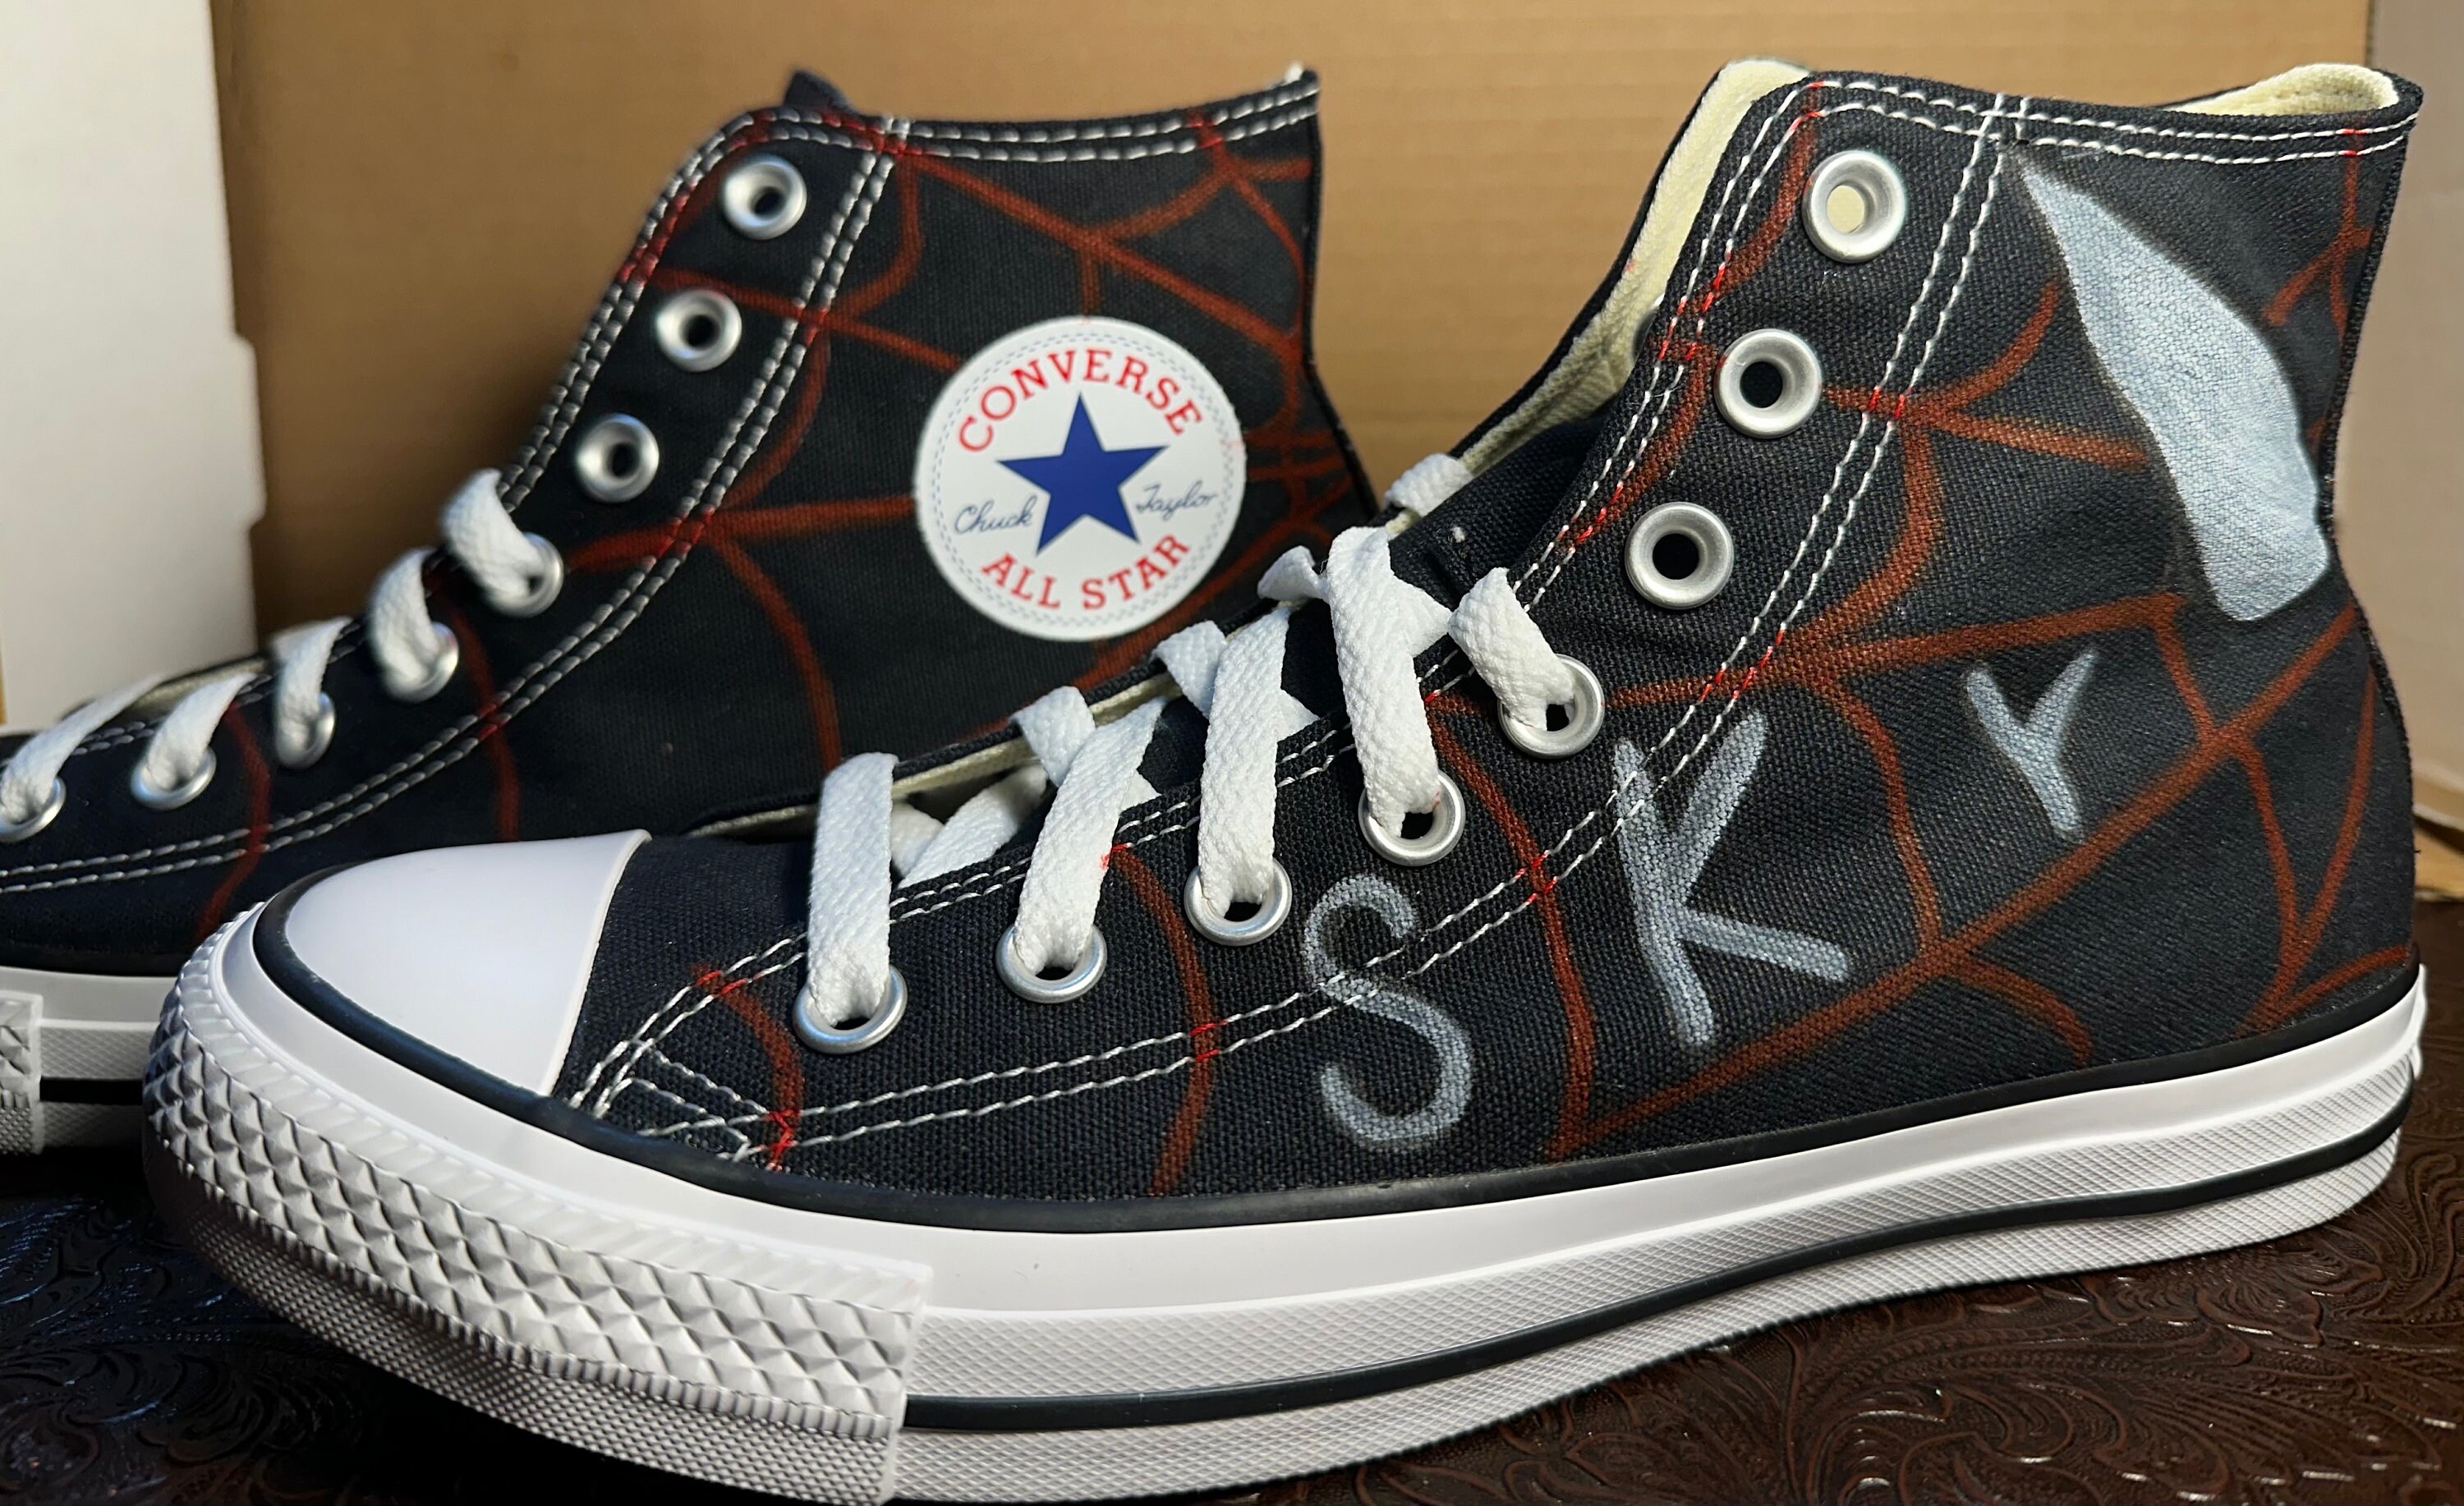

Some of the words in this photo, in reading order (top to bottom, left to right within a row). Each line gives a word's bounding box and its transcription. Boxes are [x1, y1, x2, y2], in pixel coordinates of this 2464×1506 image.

[959, 349, 1203, 452] CONVERSE
[955, 494, 1038, 534] Chuck
[1135, 480, 1218, 521] Taylor
[981, 553, 1060, 610] ALL
[1081, 535, 1191, 610] STAR
